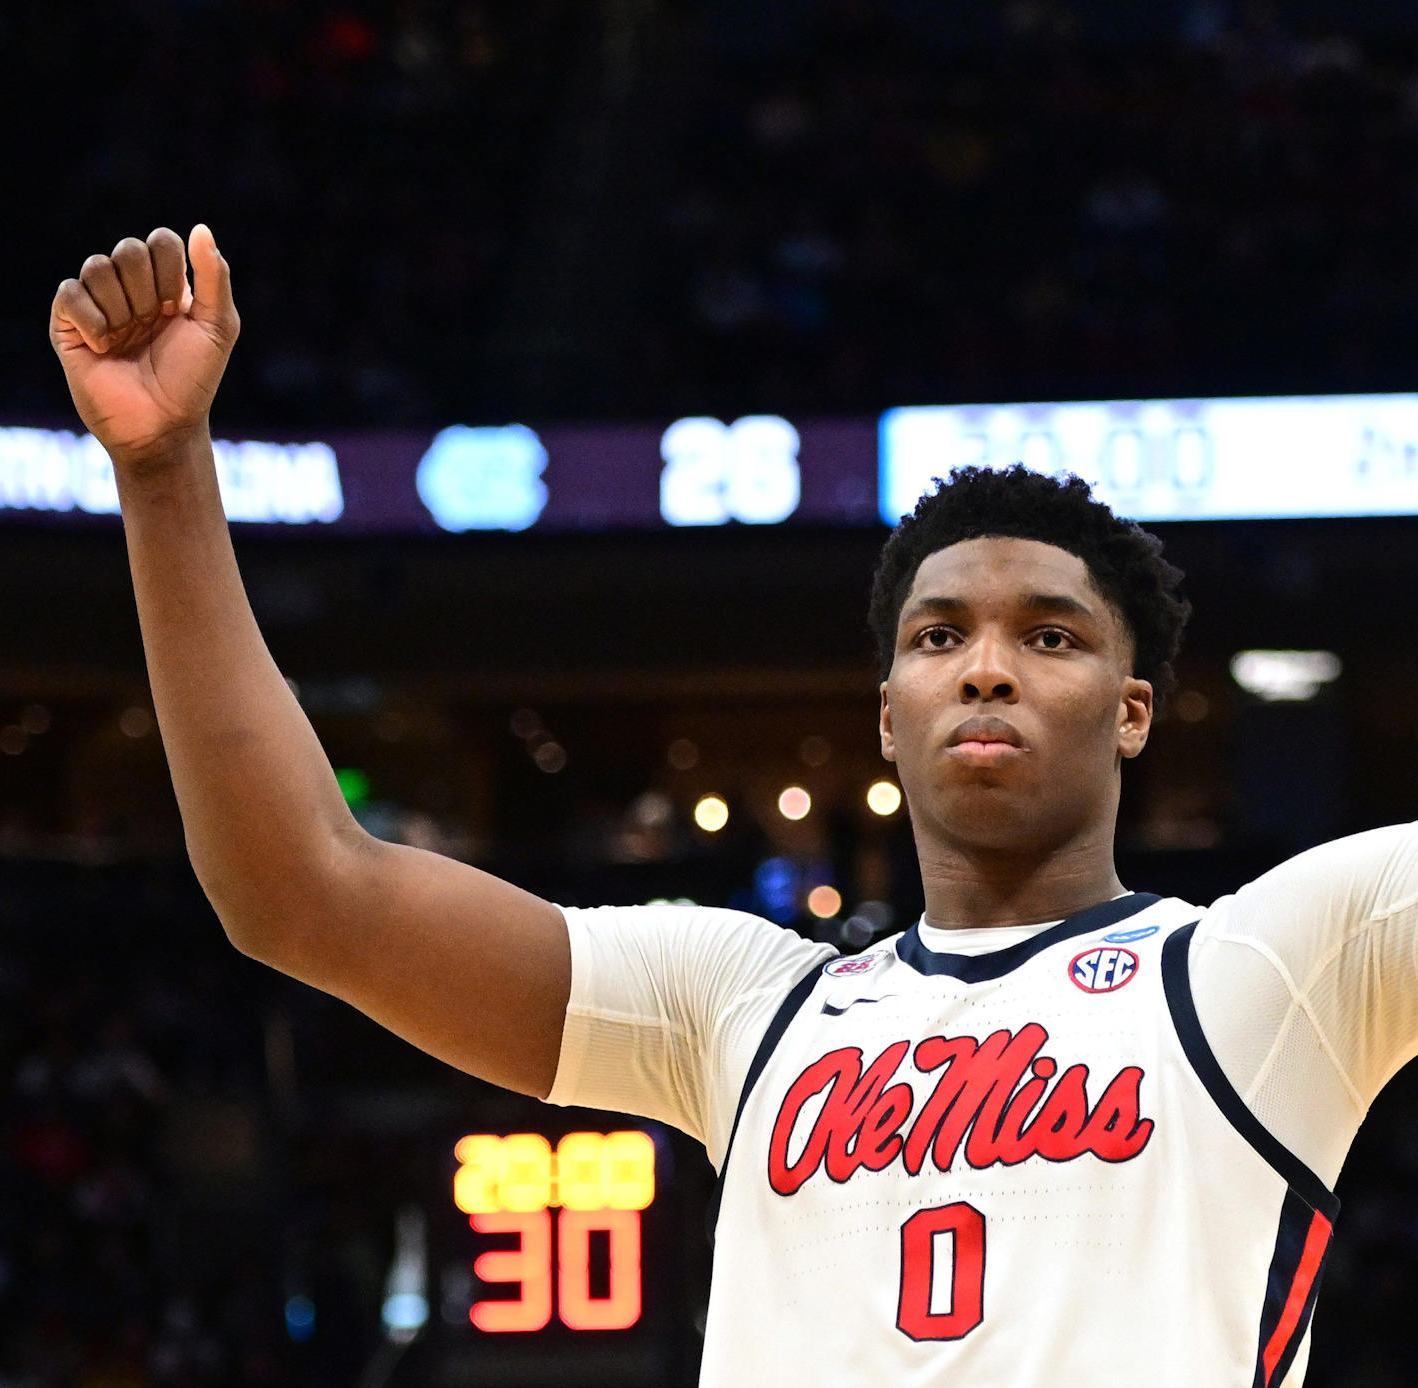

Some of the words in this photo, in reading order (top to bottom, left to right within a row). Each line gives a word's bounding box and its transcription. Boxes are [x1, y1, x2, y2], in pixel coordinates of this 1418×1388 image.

[1073, 947, 1137, 991] SEC
[469, 1207, 642, 1332] 30
[895, 1201, 986, 1342] 0
